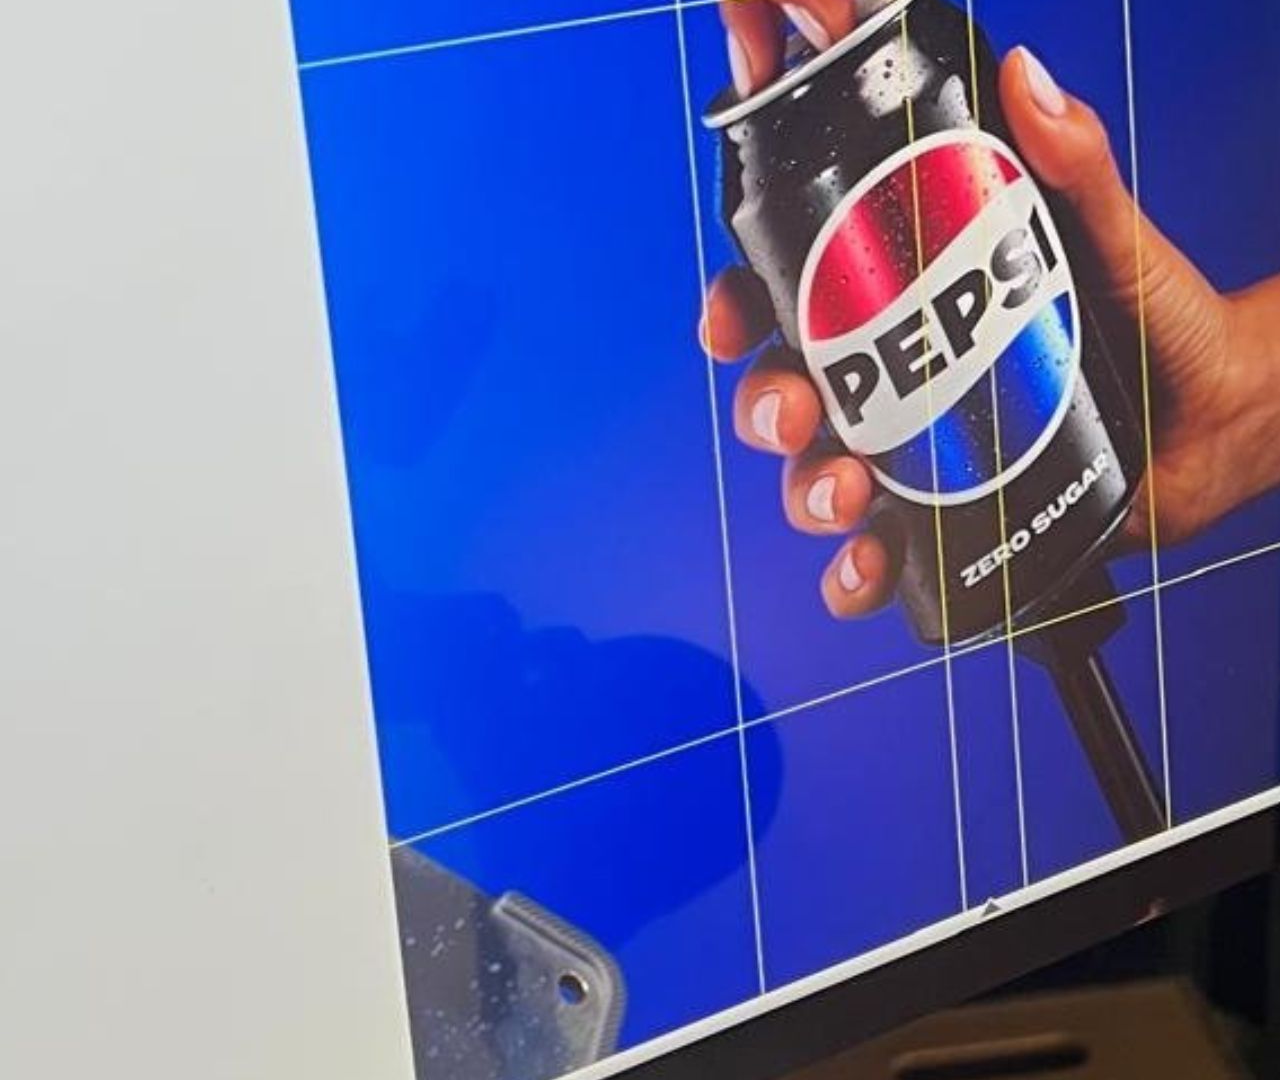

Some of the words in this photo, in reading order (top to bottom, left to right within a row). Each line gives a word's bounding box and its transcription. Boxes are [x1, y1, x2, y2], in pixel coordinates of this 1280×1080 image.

[824, 205, 1058, 426] PEPSI
[960, 531, 1031, 588] ZERO
[1031, 453, 1110, 535] SUGAR
